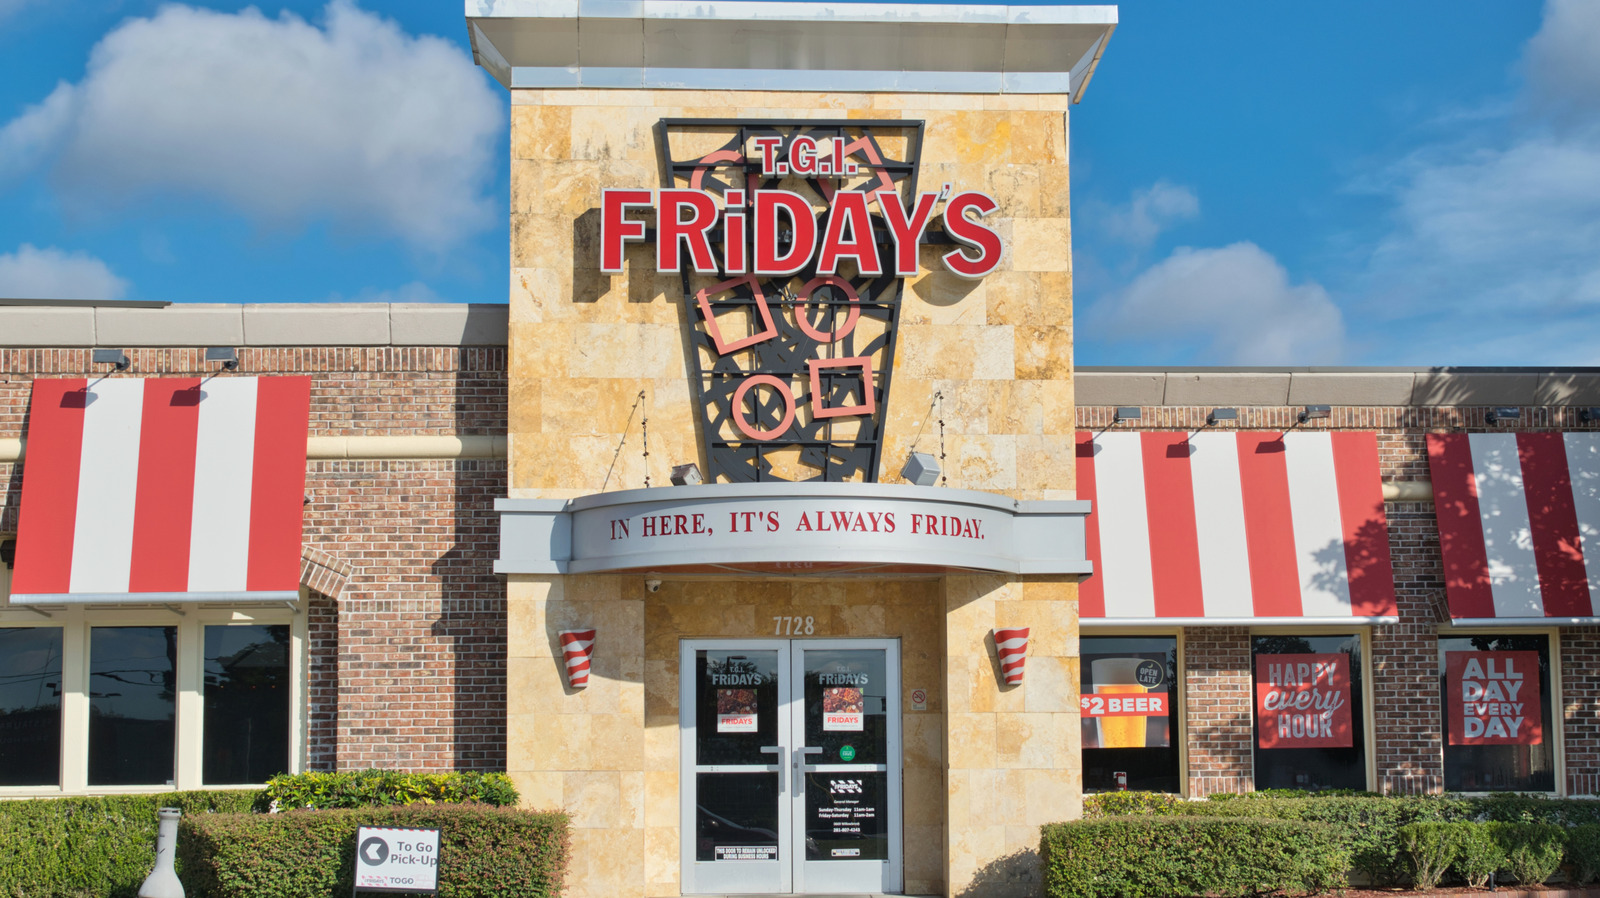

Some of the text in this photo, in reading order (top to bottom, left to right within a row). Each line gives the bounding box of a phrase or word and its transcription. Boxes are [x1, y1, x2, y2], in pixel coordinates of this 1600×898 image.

[754, 135, 859, 176] T.G.I.
[610, 510, 985, 541] IN HERE, IT'S ALWAYS FRIDAY.
[773, 616, 815, 636] 7728
[1139, 667, 1158, 677] OPEN
[1268, 662, 1337, 687] HAPPY
[1462, 658, 1523, 680] ALL
[1139, 675, 1158, 684] LATE
[1462, 680, 1524, 702] DAY
[1081, 697, 1163, 715] $2 BEER
[1263, 687, 1345, 720] every
[1463, 702, 1524, 716] EVERY
[827, 716, 859, 724] FRIDAYS
[1278, 714, 1333, 738] HOUR
[1463, 716, 1525, 738] DAY
[397, 841, 433, 853] To Go
[390, 854, 437, 867] Pick-Up
[390, 876, 414, 885] TOGO
